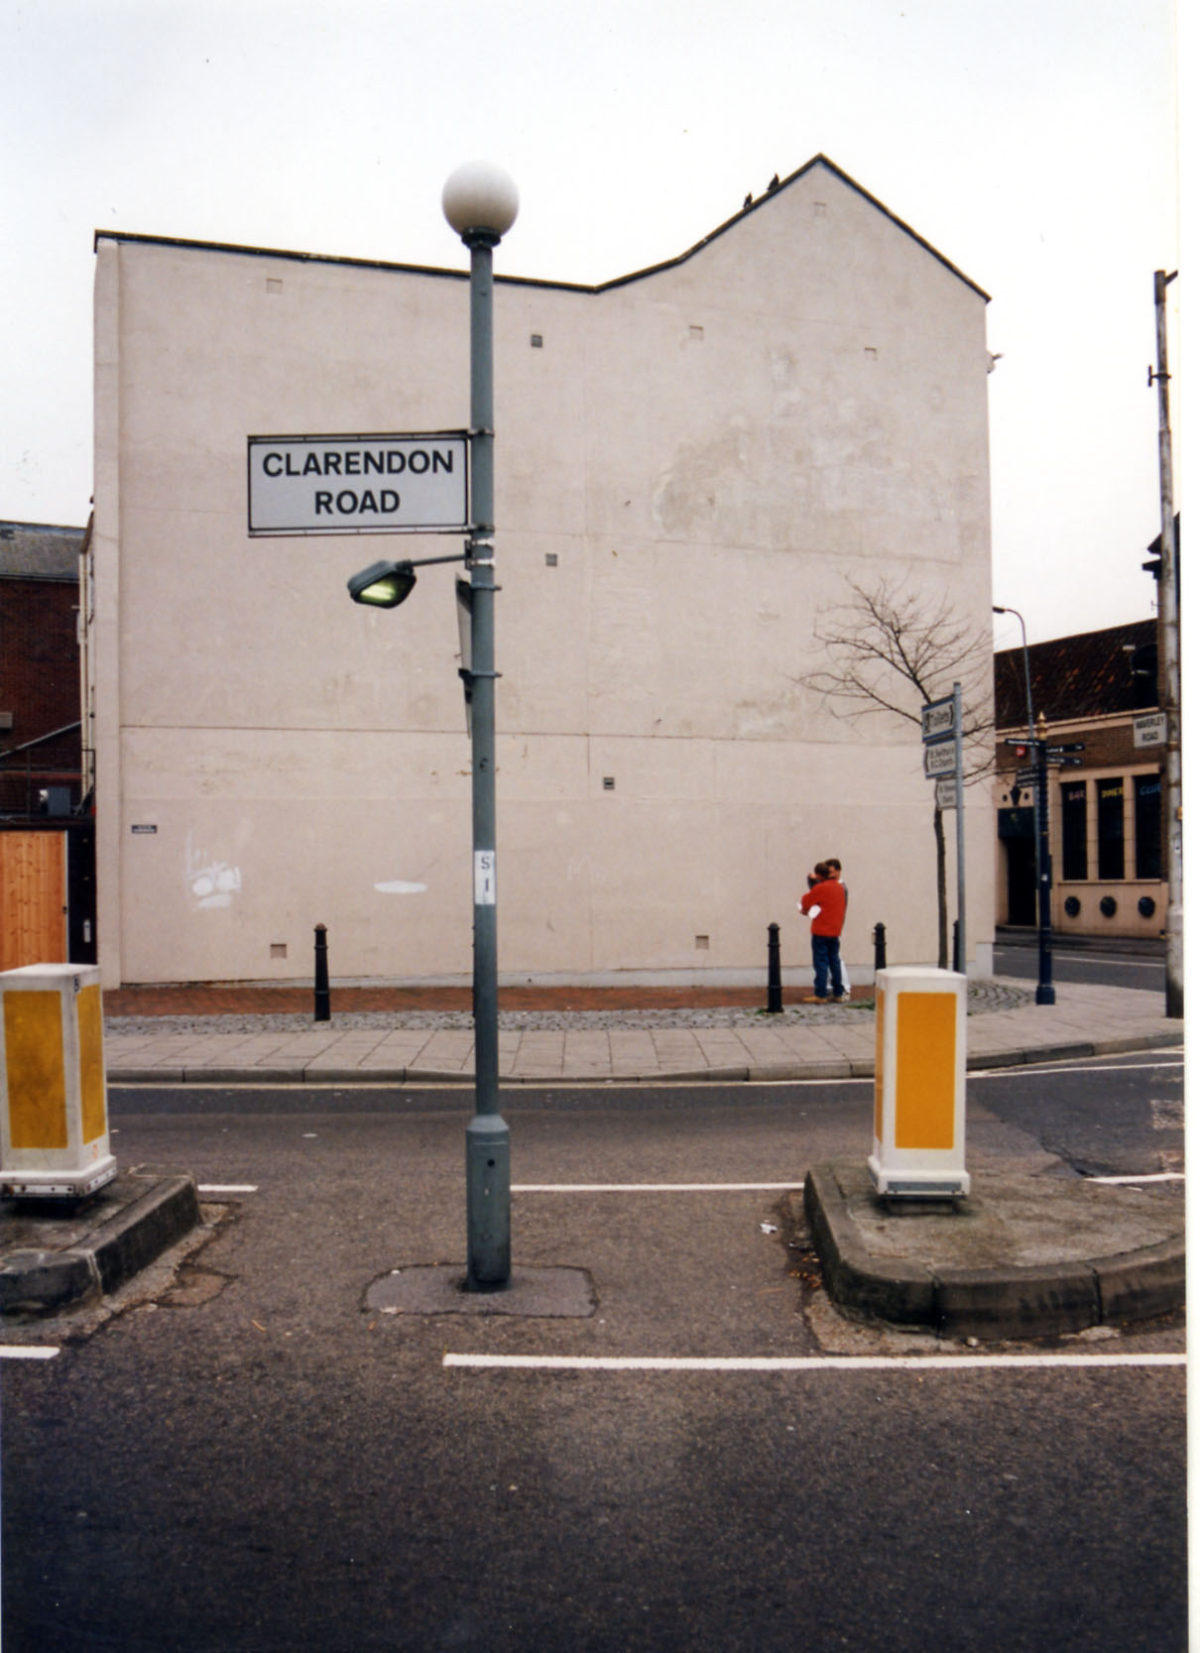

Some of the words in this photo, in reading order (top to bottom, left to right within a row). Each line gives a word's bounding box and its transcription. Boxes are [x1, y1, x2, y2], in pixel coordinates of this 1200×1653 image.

[262, 450, 453, 477] CLARENDON
[314, 489, 401, 515] ROAD
[1136, 716, 1165, 729] WAVERLEY
[1142, 731, 1159, 742] ROAD
